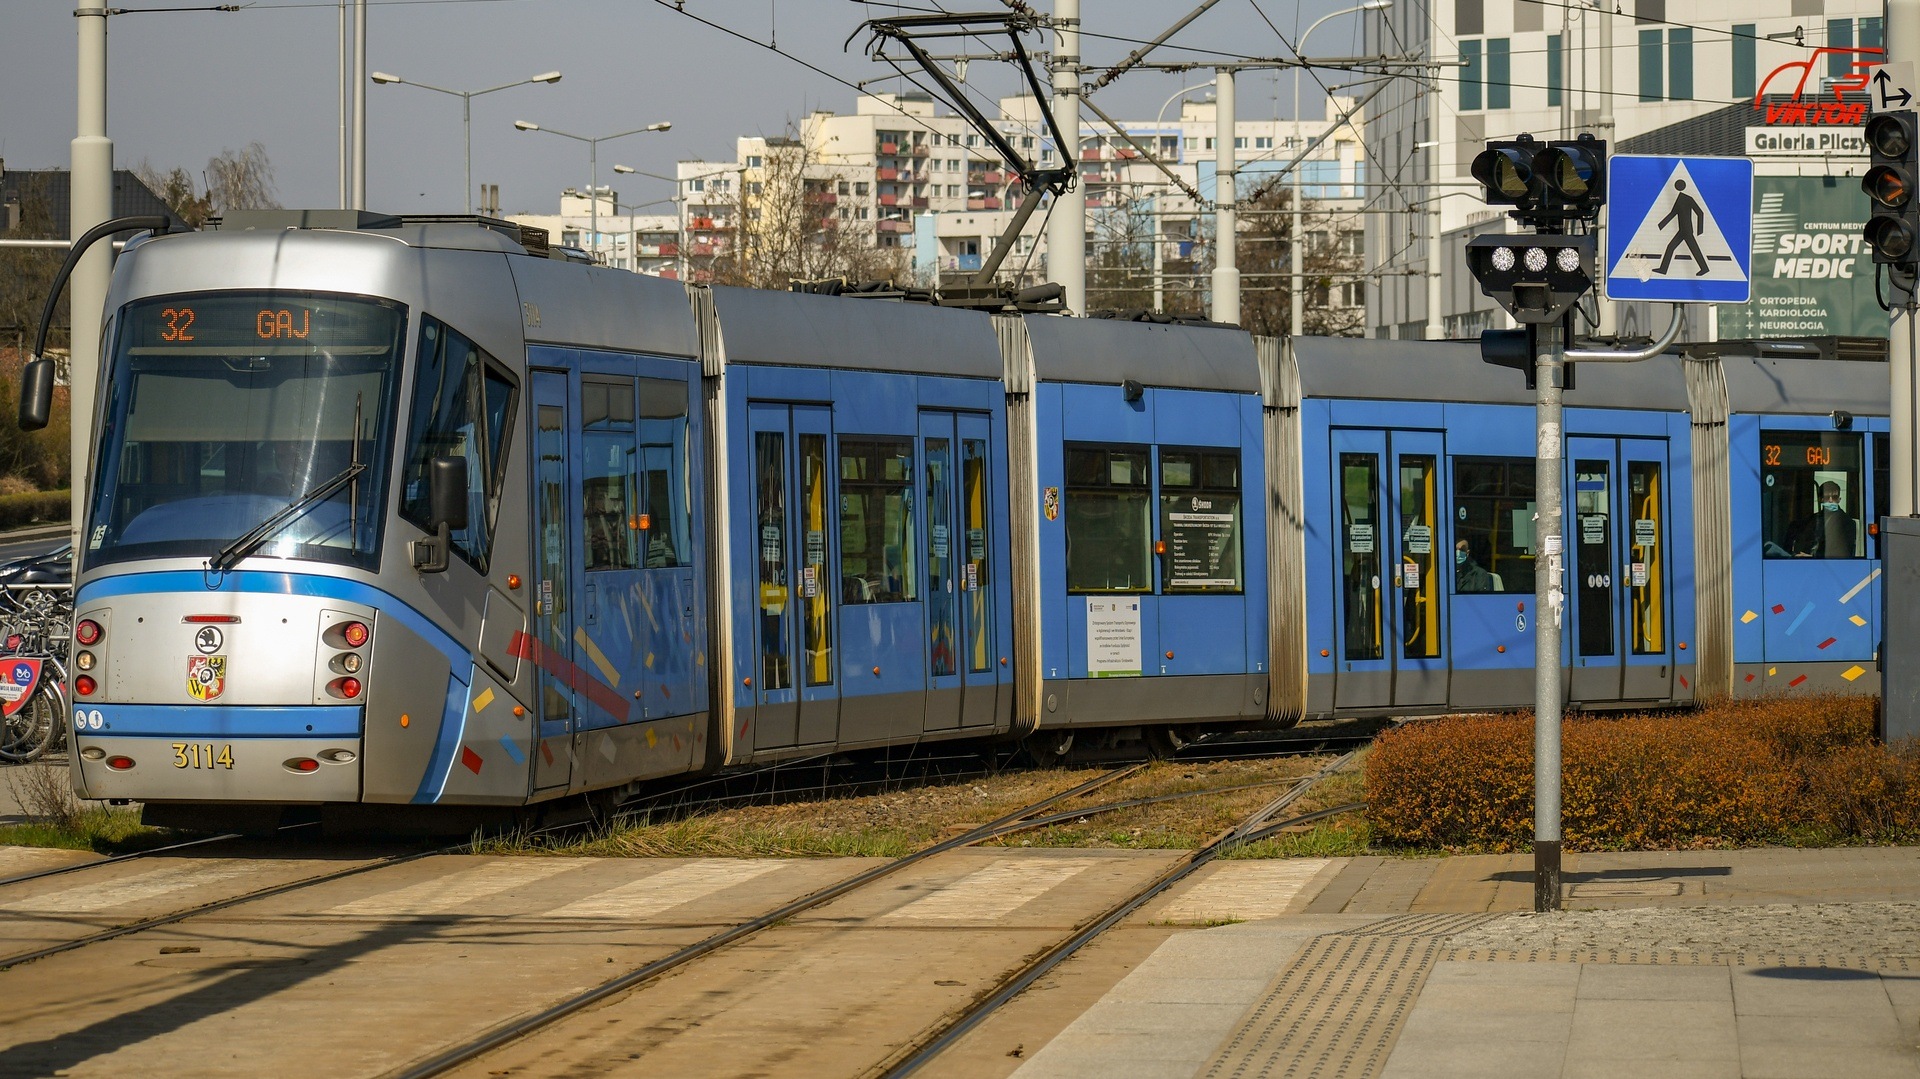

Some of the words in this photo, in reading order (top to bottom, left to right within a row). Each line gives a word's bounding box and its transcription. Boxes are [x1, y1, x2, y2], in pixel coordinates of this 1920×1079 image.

[1766, 102, 1866, 124] VIKTOR
[1755, 133, 1815, 150] Galeria
[1804, 222, 1840, 230] CENTRUM
[1773, 258, 1855, 279] MEDIC
[1759, 297, 1817, 305] ORTOPEDIA
[1759, 309, 1828, 317] KARDIOLOGIA
[161, 308, 196, 341] 32
[257, 309, 310, 339] GAJ
[1759, 321, 1825, 330] NEUROLOGIA
[1764, 445, 1781, 466] 32
[1806, 446, 1830, 465] GAJ
[92, 529, 104, 541] 15
[172, 743, 235, 770] 3114
